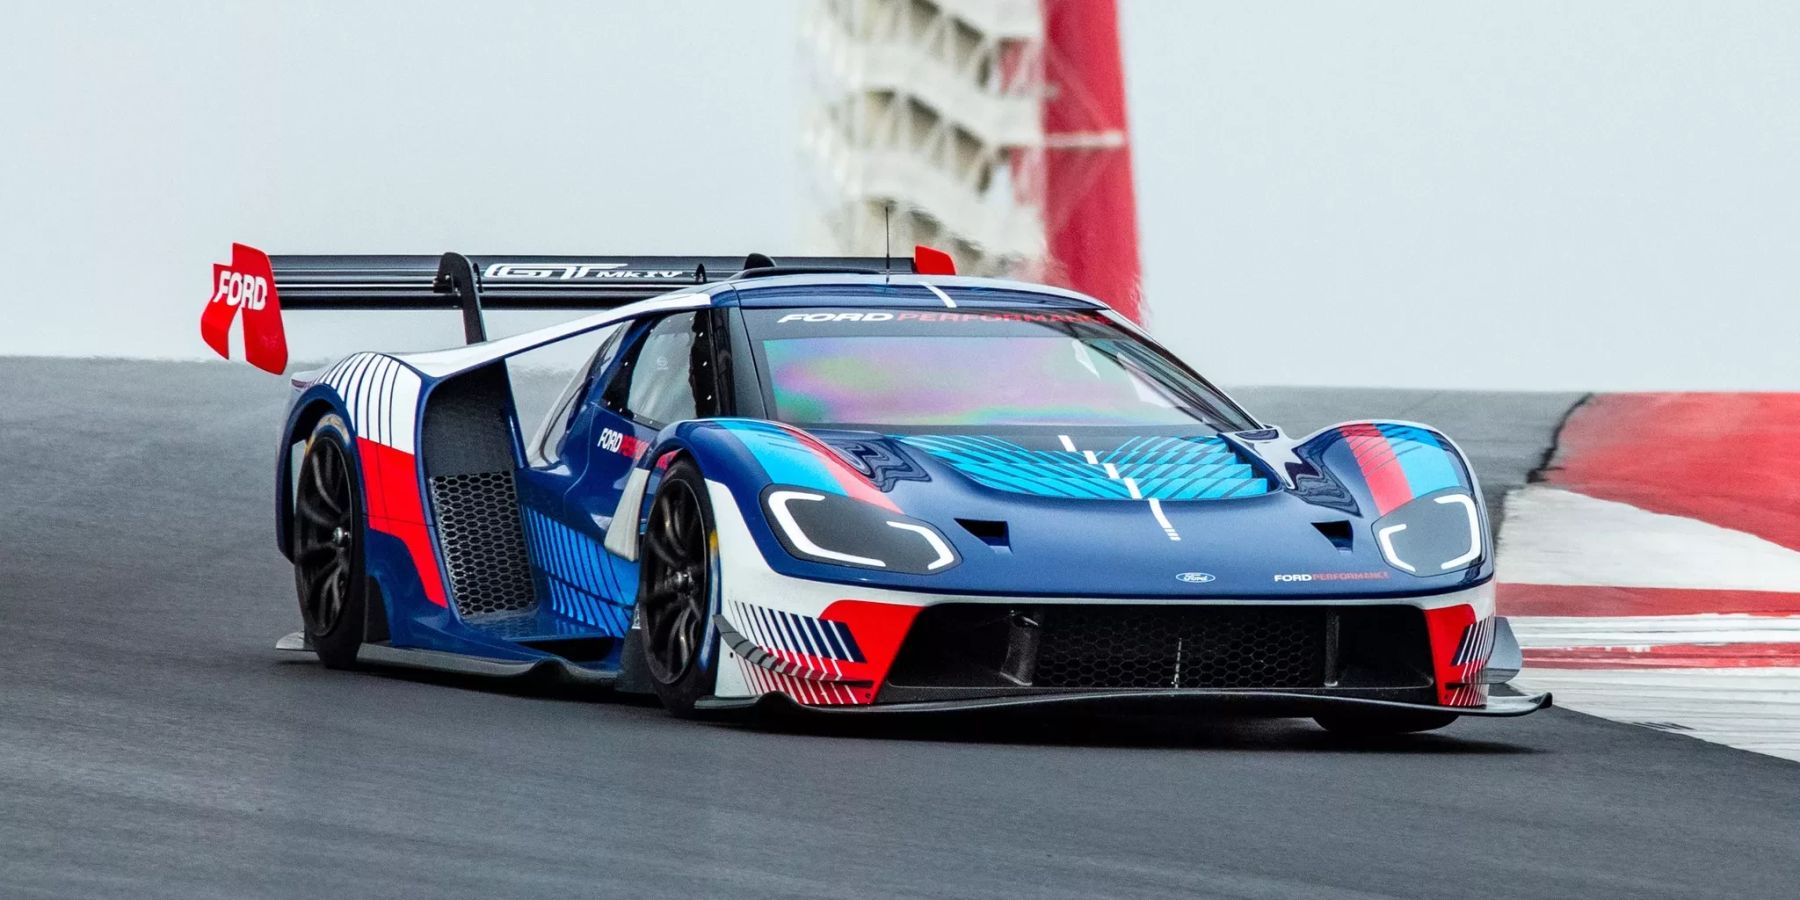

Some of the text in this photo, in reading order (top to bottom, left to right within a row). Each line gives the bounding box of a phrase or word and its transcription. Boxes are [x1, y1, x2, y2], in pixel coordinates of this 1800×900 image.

[484, 263, 628, 280] GT
[213, 271, 268, 310] FORD
[778, 313, 894, 323] FORD
[597, 427, 623, 453] FORD
[1274, 571, 1390, 582] FORD PERFORMANCE
